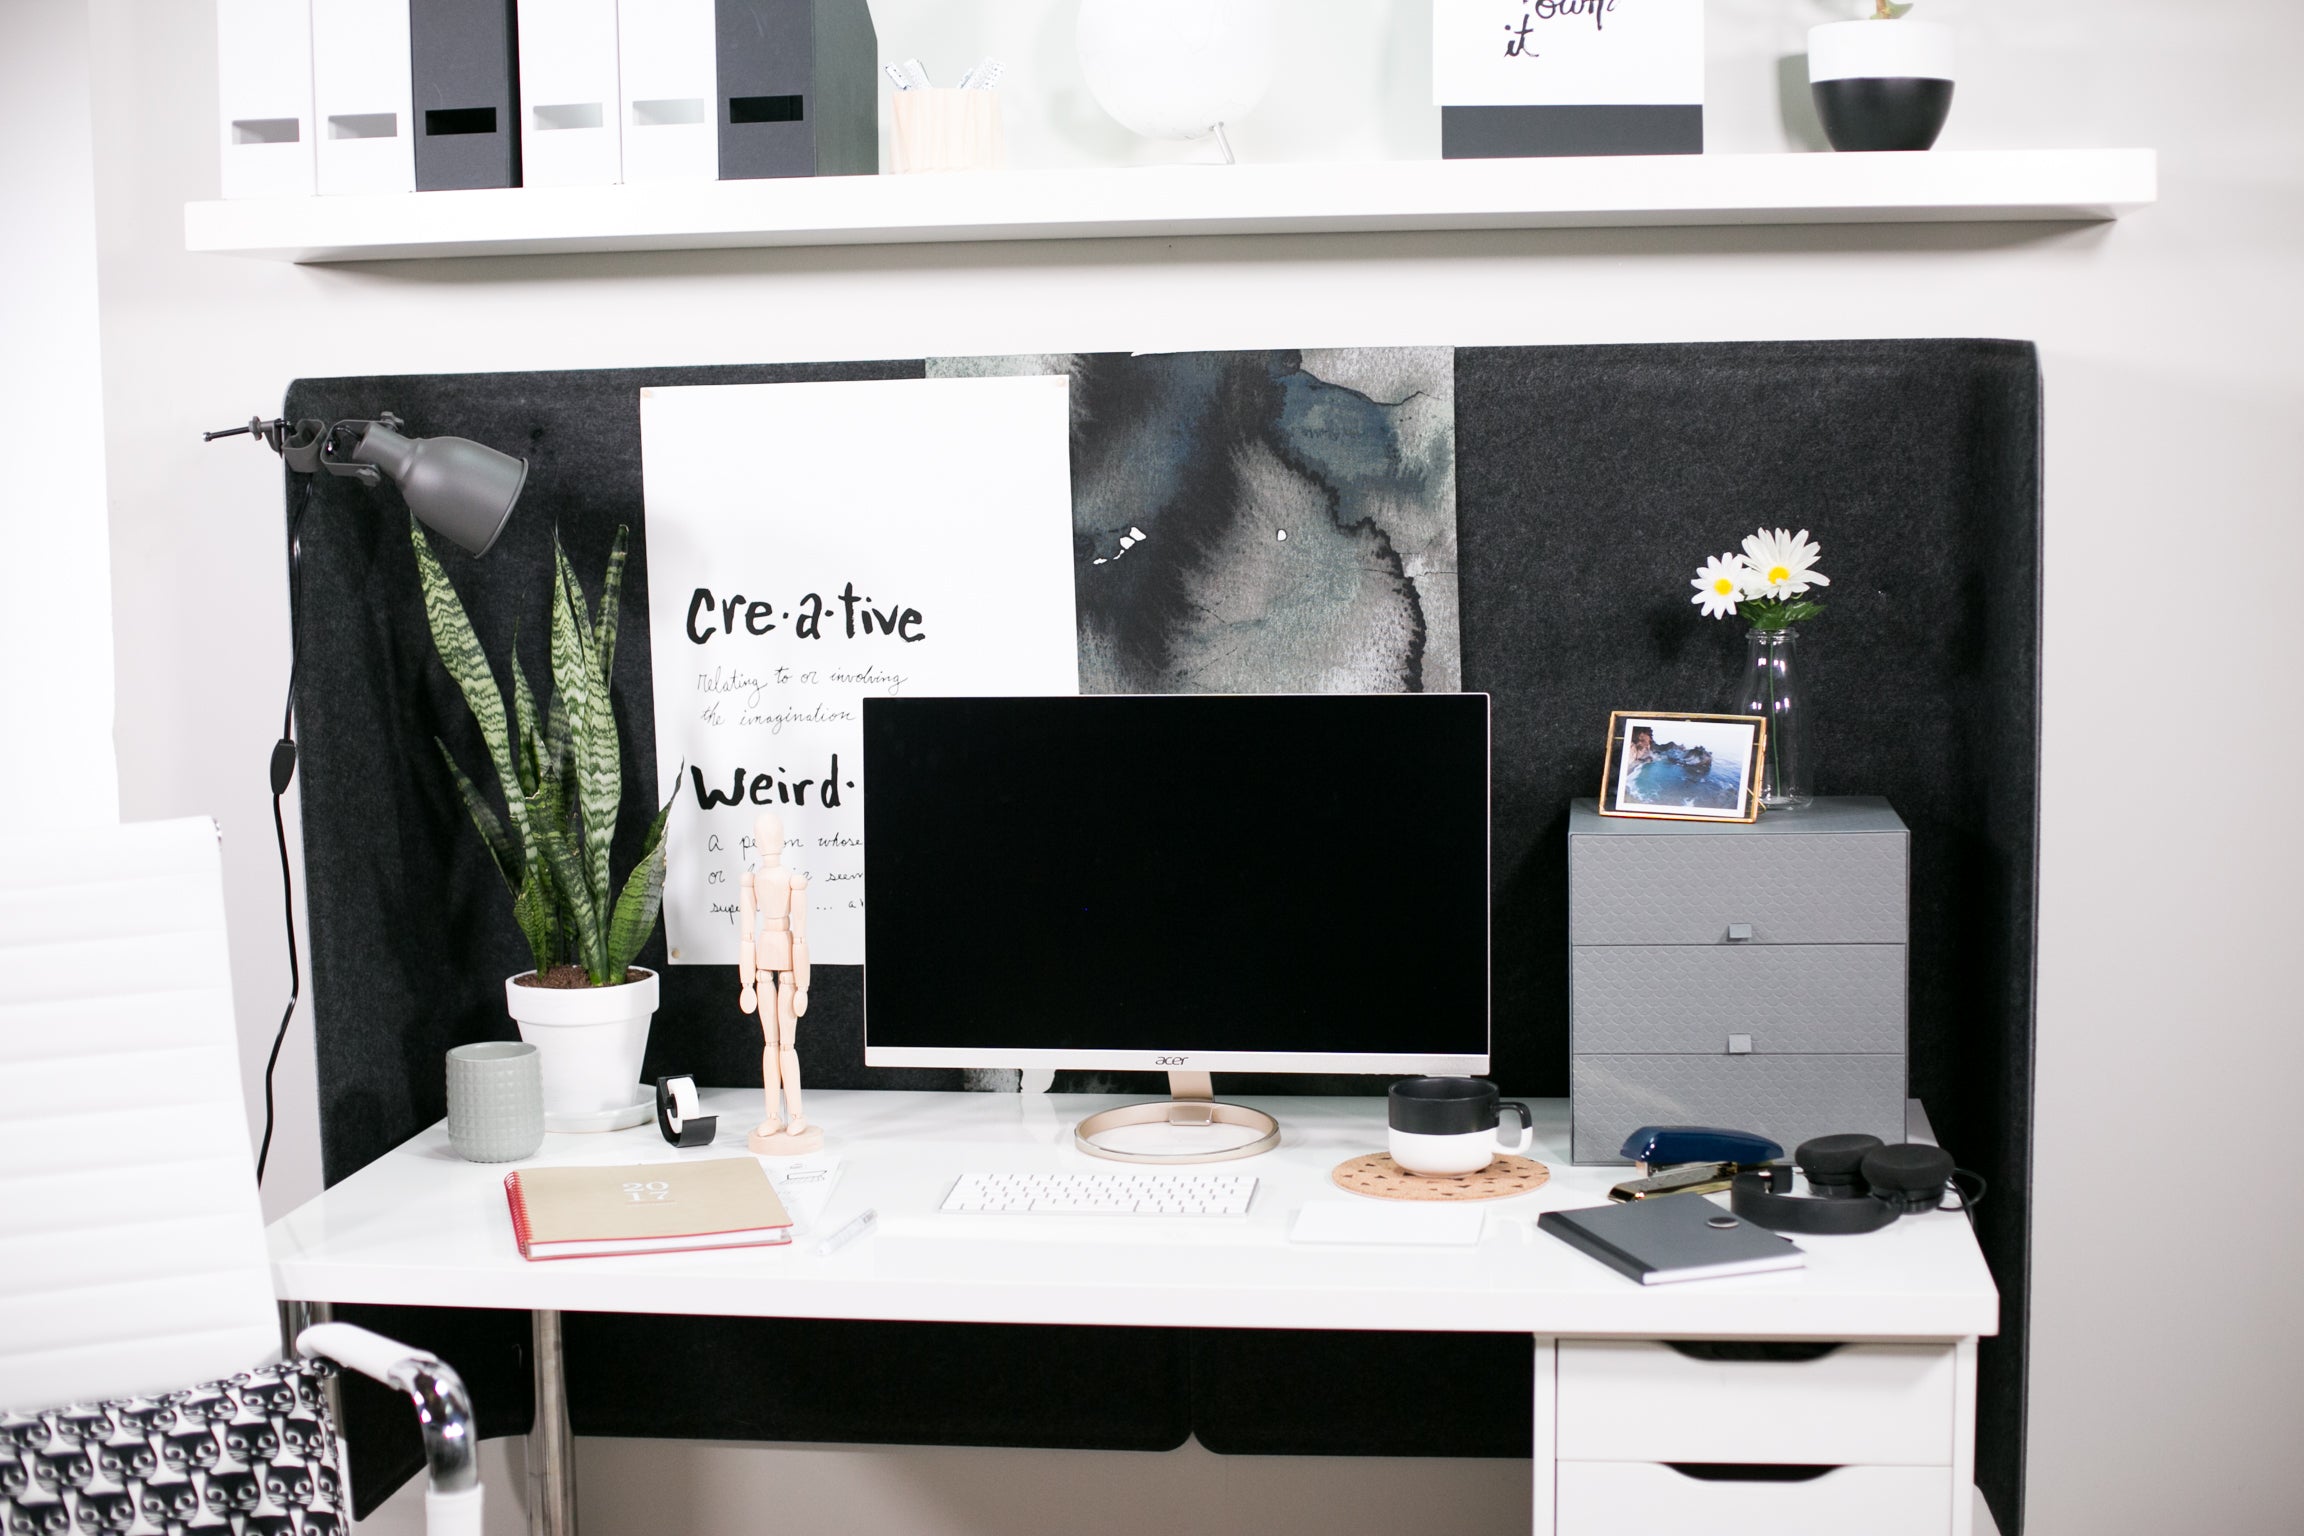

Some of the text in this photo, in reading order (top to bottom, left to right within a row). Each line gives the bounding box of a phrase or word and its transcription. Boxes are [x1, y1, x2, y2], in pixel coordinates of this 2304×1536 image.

[1503, 13, 1540, 58] it
[696, 664, 908, 708] relating to or involving
[700, 701, 856, 735] the imagination
[817, 832, 863, 847] whose
[1154, 1056, 1189, 1065] acer
[622, 1181, 670, 1193] 20
[627, 1190, 670, 1202] 17
